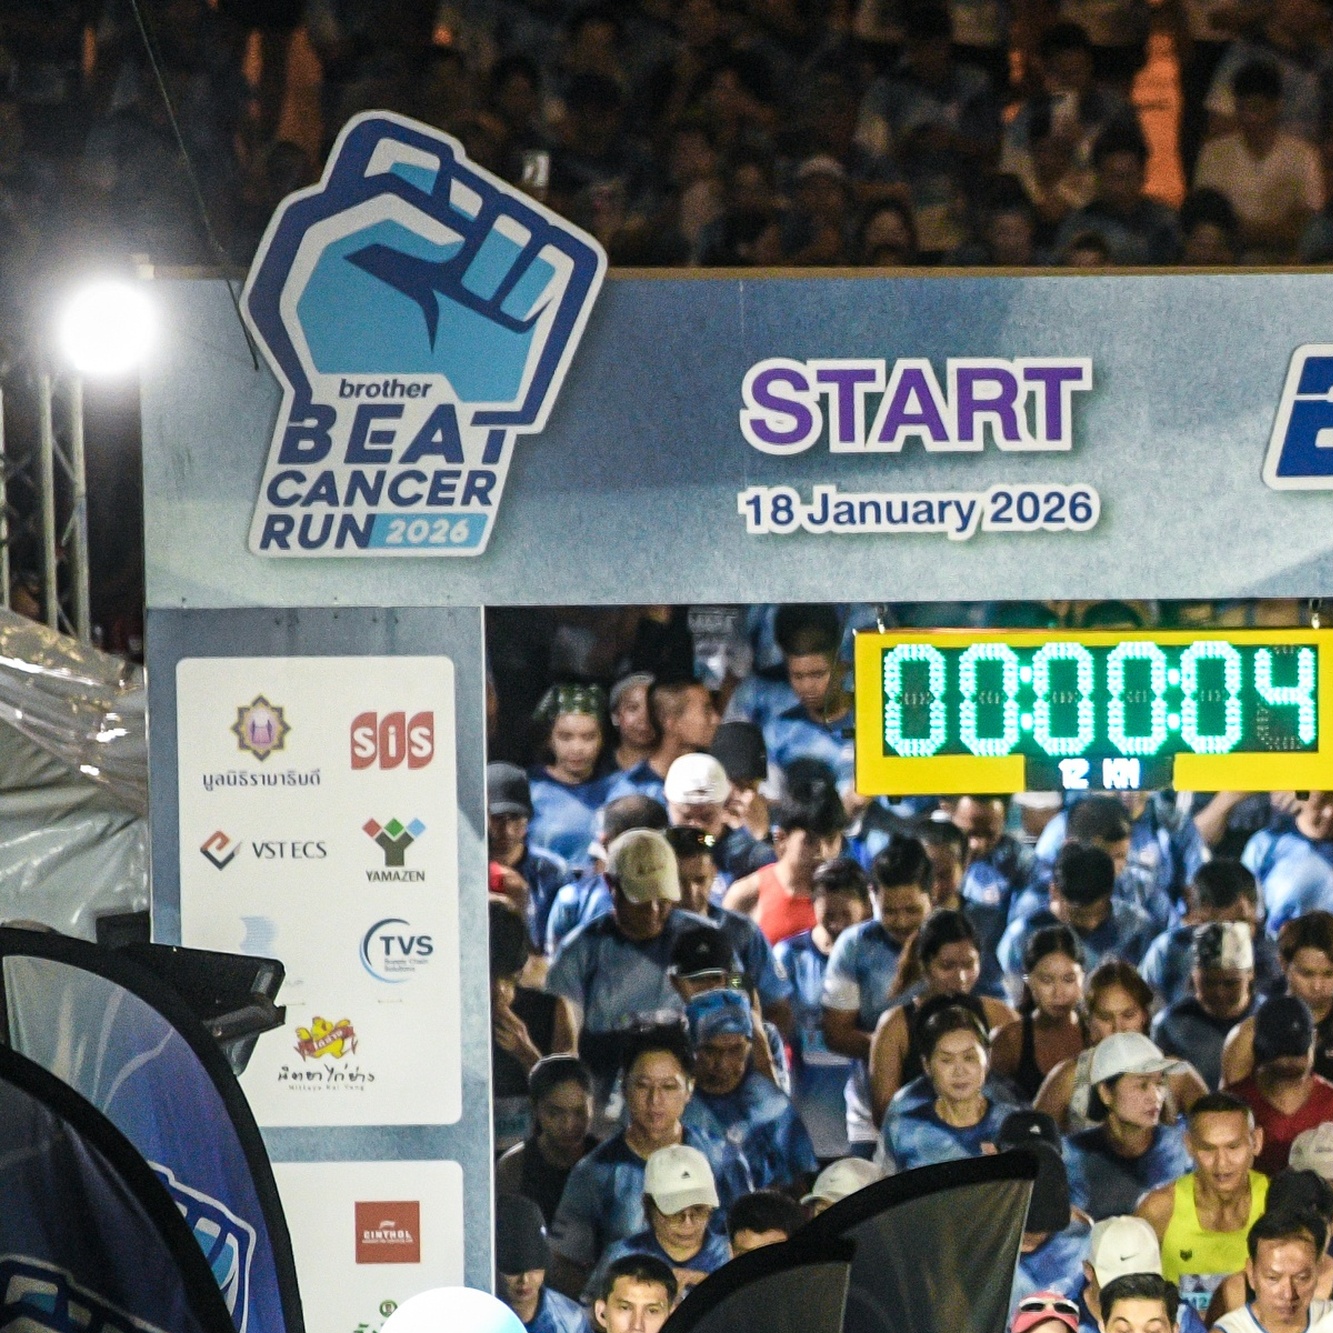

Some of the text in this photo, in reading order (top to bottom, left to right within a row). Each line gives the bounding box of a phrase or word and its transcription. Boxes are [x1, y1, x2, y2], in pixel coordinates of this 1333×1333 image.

[338, 378, 432, 400] brother
[749, 367, 1083, 446] START
[278, 404, 508, 465] BEAT
[266, 470, 497, 507] CANCER
[745, 491, 1093, 532] 18 January 2026
[260, 513, 469, 550] RUN 2026
[884, 639, 1316, 757] 00:00:04
[1058, 758, 1140, 789] 12 KM
[365, 870, 426, 883] YAMAZEN
[379, 935, 434, 957] TVS
